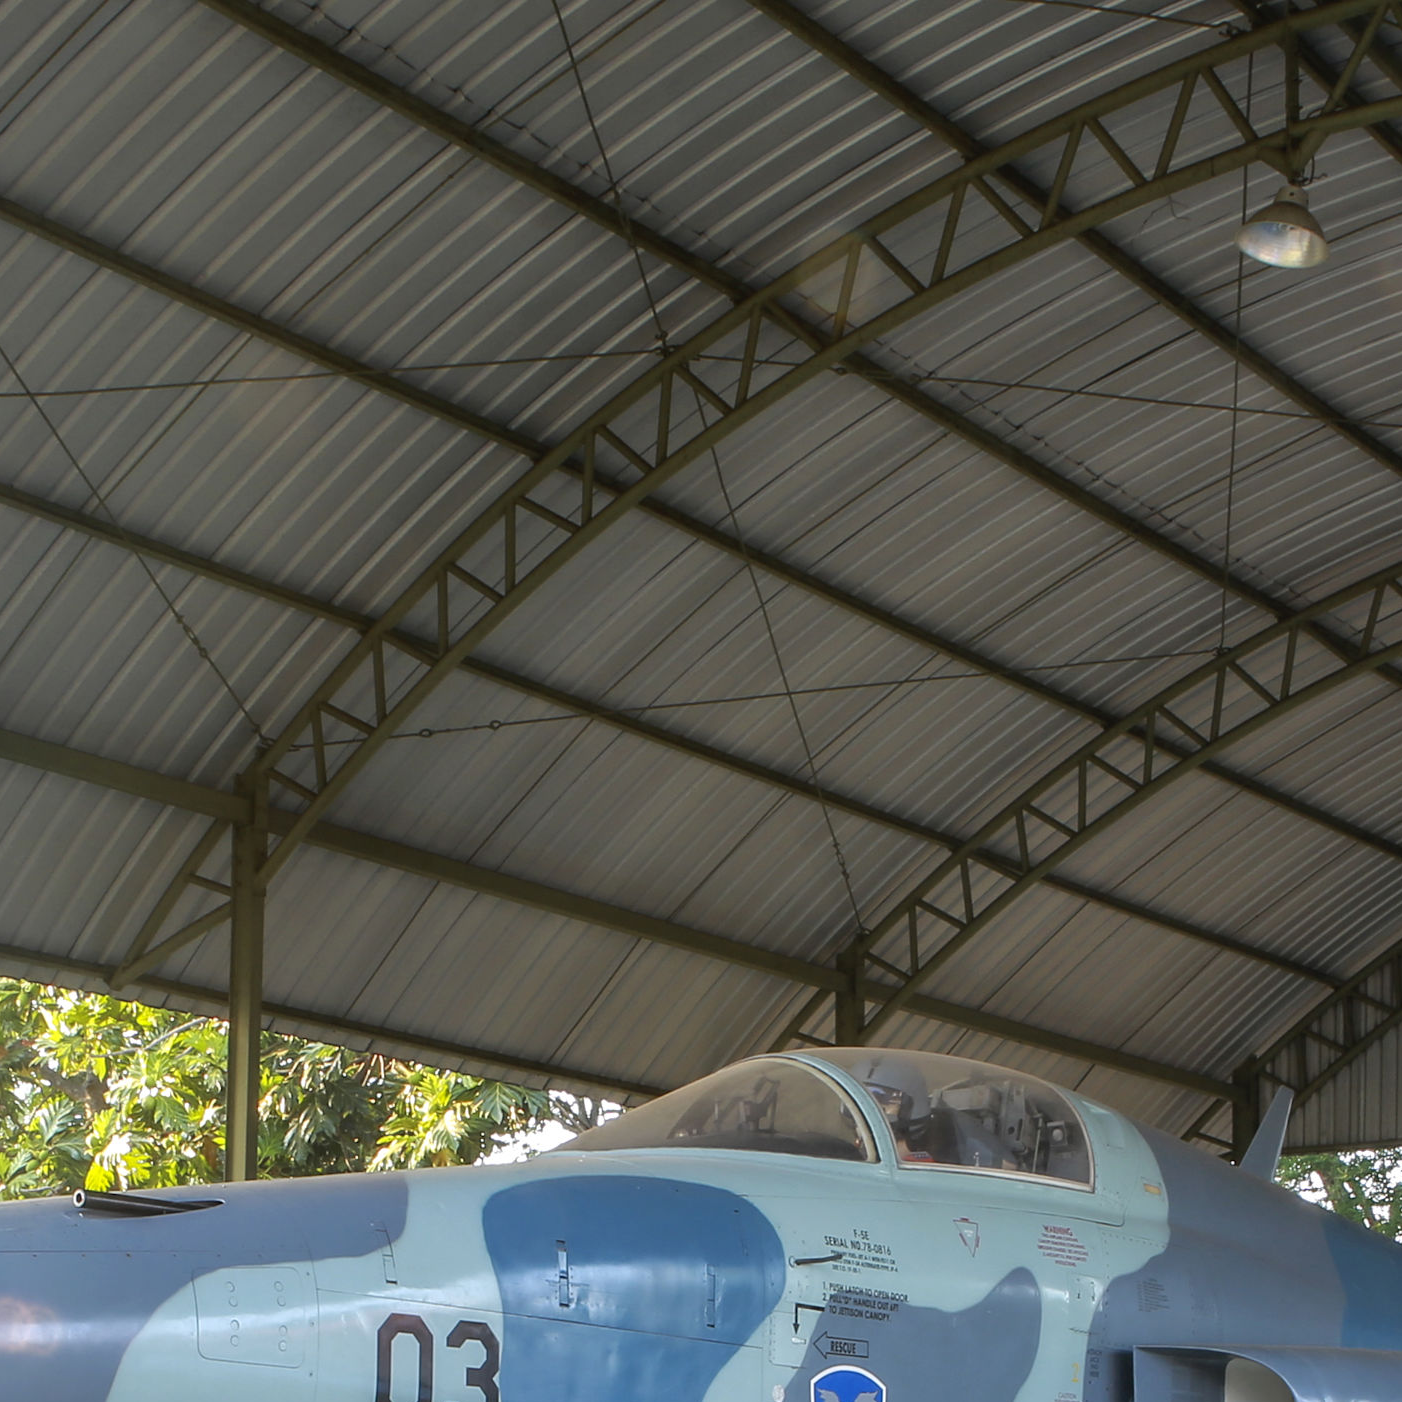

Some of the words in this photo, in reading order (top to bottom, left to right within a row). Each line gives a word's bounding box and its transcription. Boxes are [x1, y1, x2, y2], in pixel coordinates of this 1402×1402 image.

[853, 1229, 870, 1240] F-5E
[824, 1235, 849, 1249] SERIAL
[829, 1282, 844, 1293] PUSH
[845, 1285, 864, 1296] LATCH
[865, 1288, 873, 1297] TO
[874, 1289, 889, 1299] OPEN
[853, 1298, 876, 1309] HANDLE
[877, 1301, 888, 1310] OUT
[829, 1305, 837, 1314] TO
[838, 1307, 864, 1318] JETTISON
[830, 1341, 856, 1354] RESCUE
